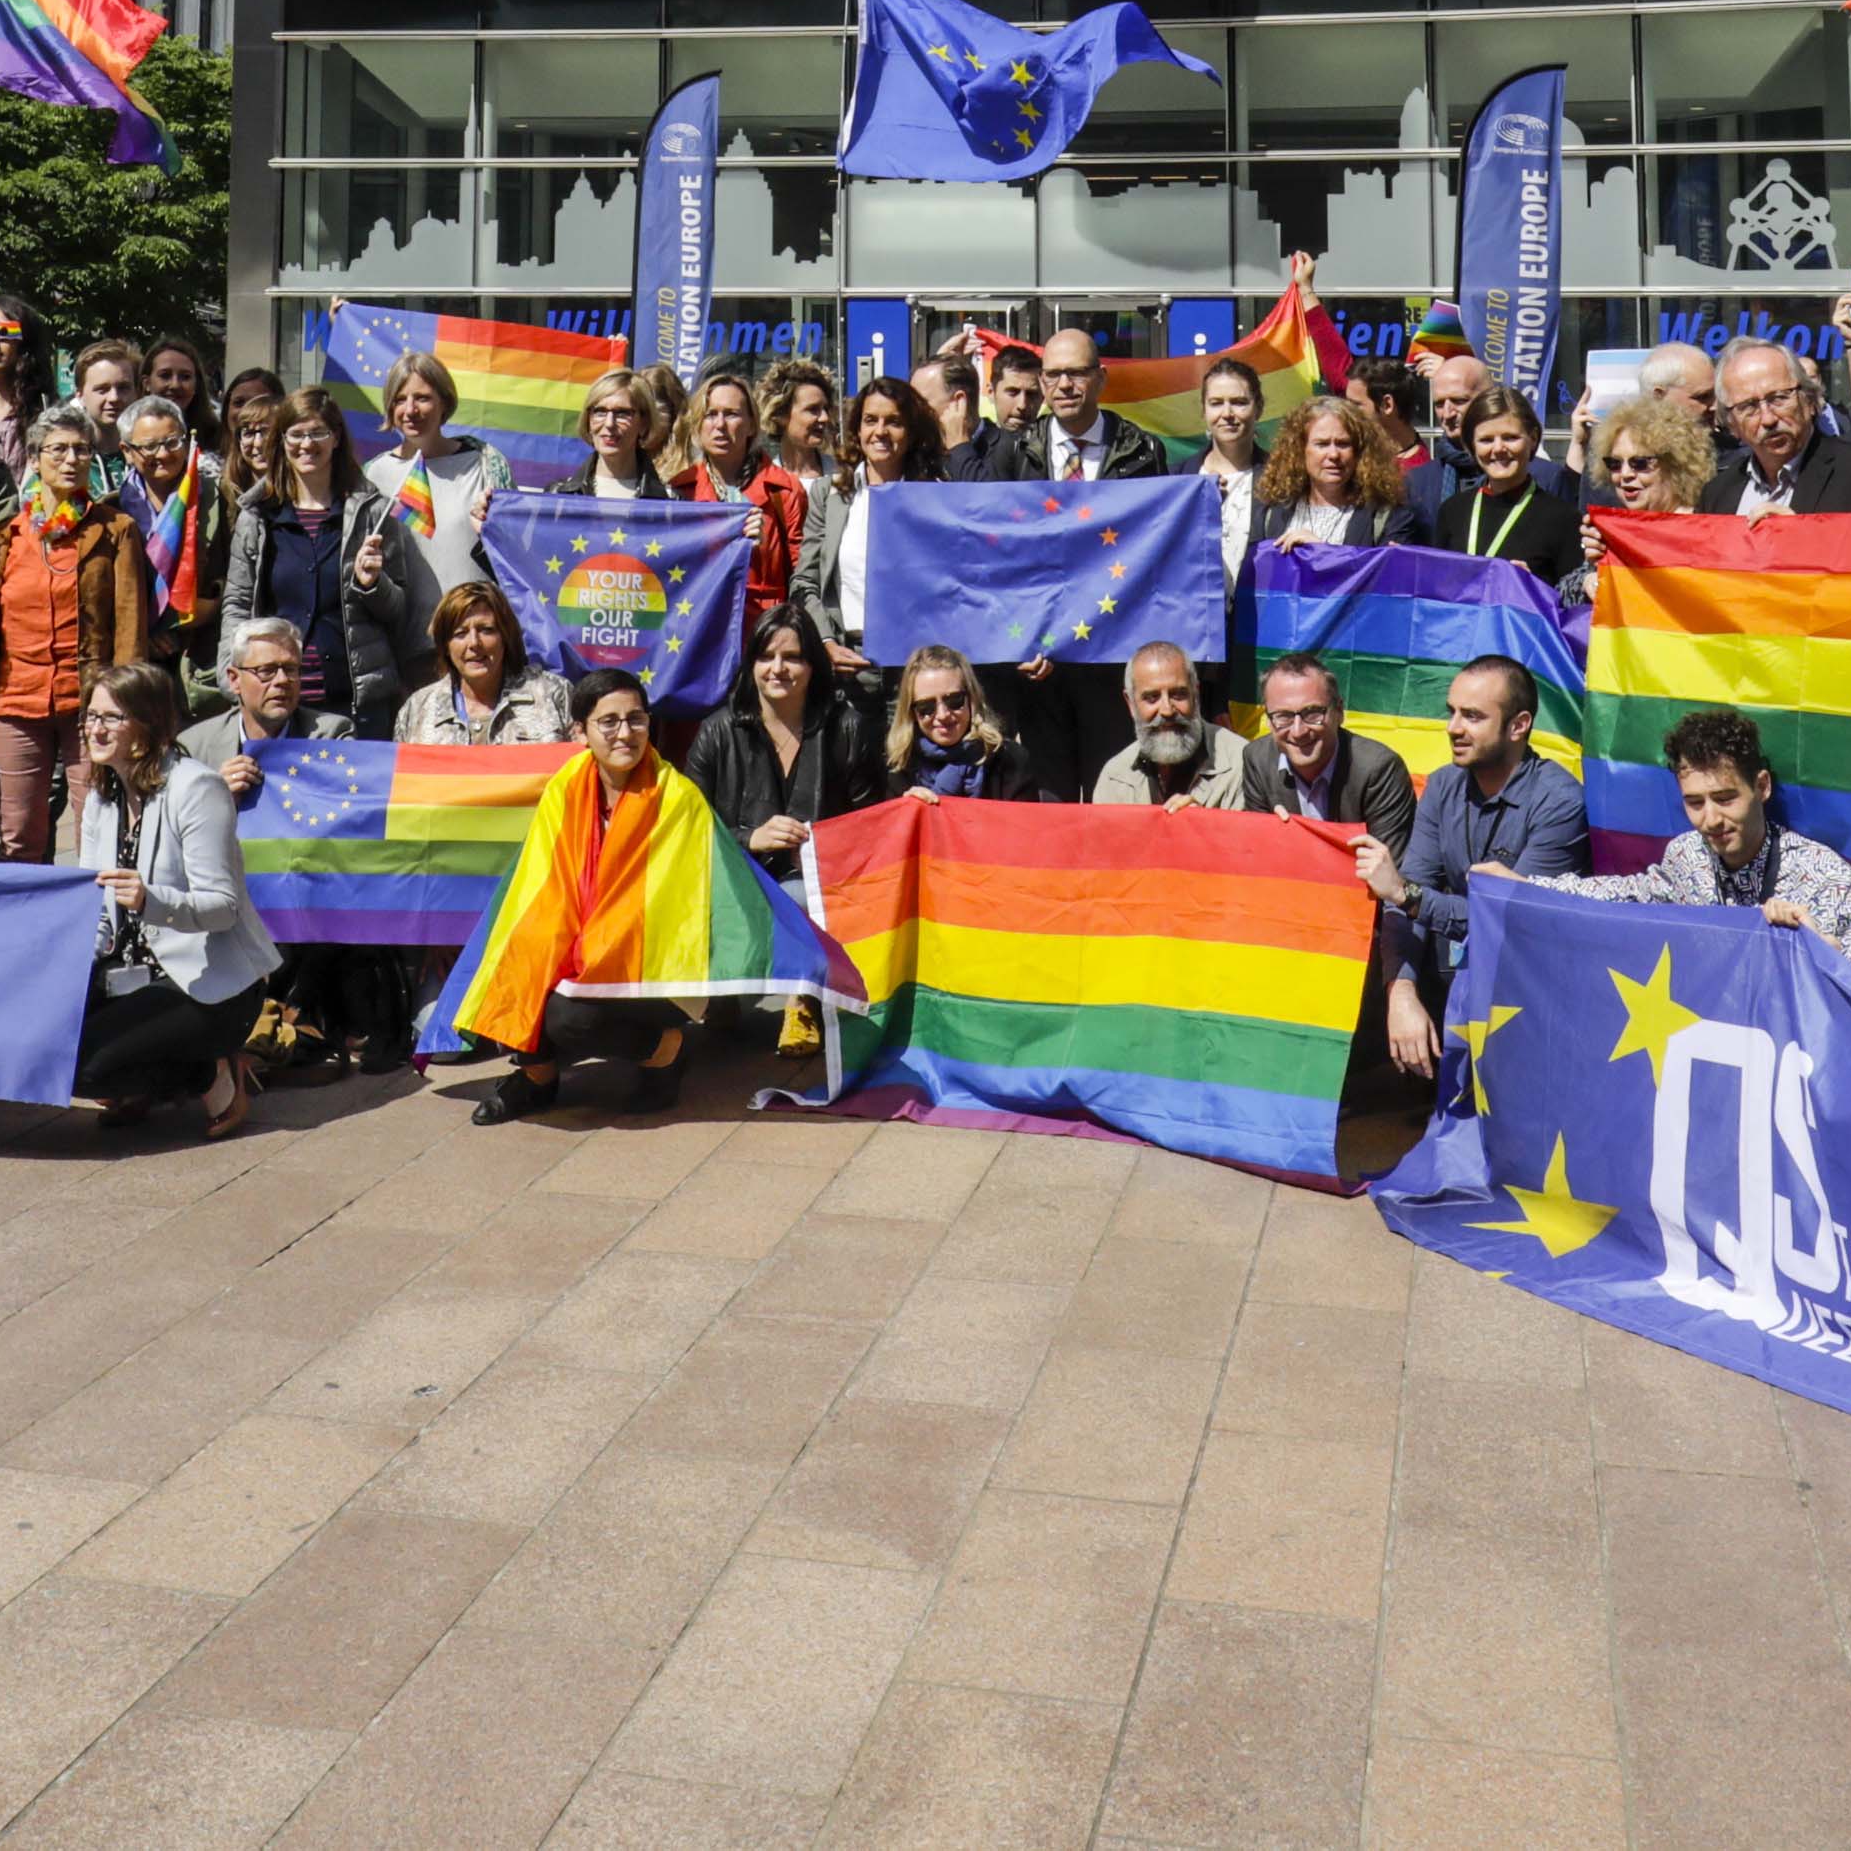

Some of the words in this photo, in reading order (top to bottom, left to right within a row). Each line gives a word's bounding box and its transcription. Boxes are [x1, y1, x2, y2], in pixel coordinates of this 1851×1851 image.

[679, 174, 703, 280] EUROPE
[1519, 168, 1549, 279] EUROPE
[657, 286, 677, 307] TO
[1487, 288, 1510, 311] TO
[587, 570, 643, 590] YOUR
[578, 590, 647, 609] RIGHTS
[590, 609, 634, 627] OUR
[581, 627, 640, 647] FIGHT
